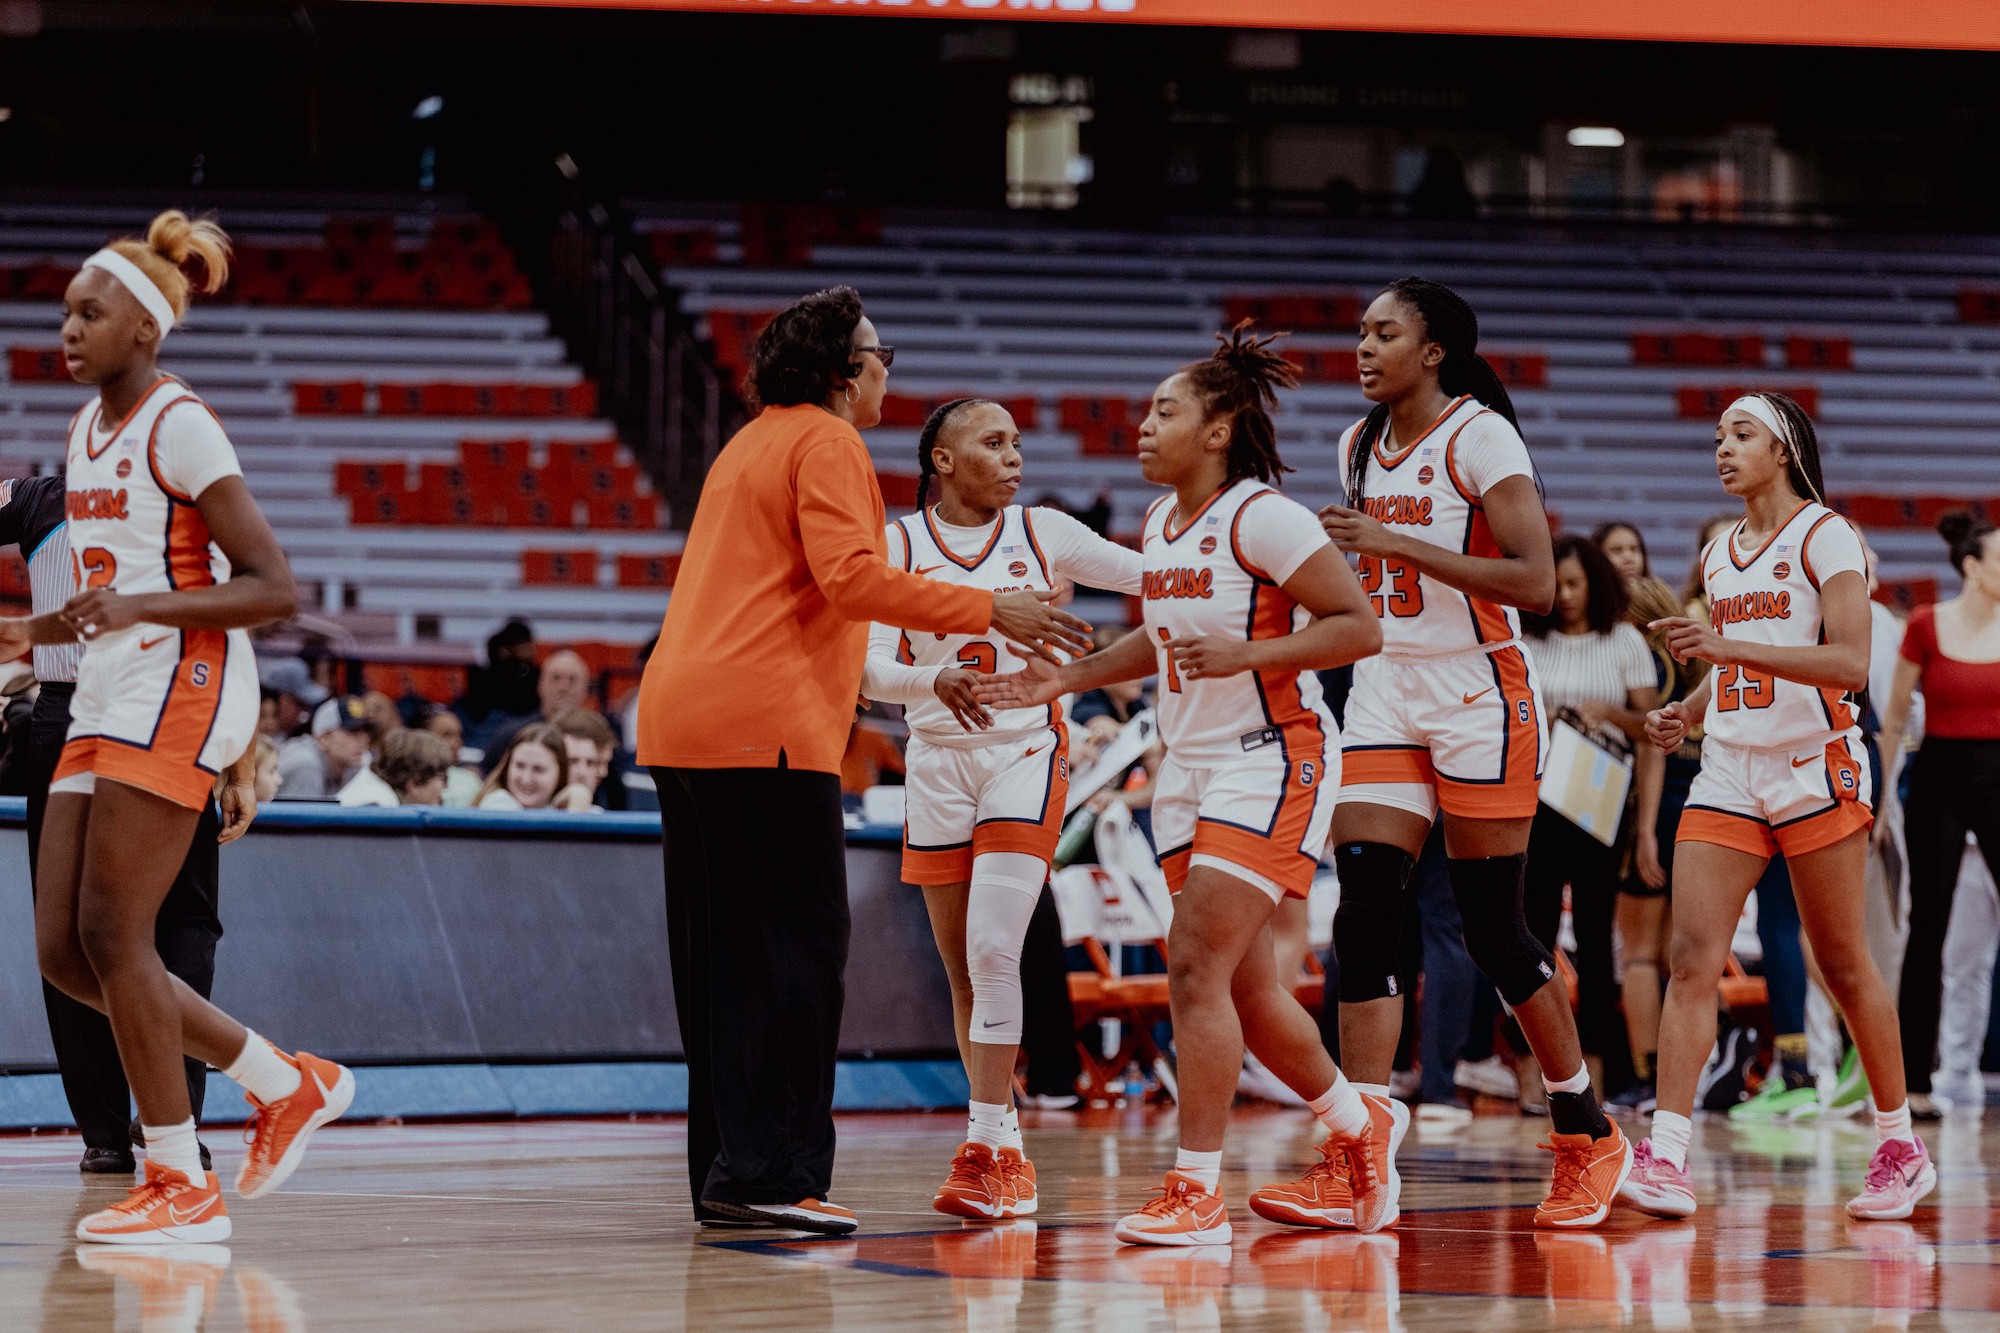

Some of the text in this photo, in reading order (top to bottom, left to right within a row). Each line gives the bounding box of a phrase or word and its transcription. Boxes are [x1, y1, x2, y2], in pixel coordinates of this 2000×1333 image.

[1359, 554, 1424, 618] 23
[1158, 627, 1182, 694] 1
[191, 662, 210, 688] S
[1717, 663, 1775, 713] 25
[1518, 700, 1531, 725] S
[1300, 761, 1316, 787] S
[1838, 767, 1855, 792] S
